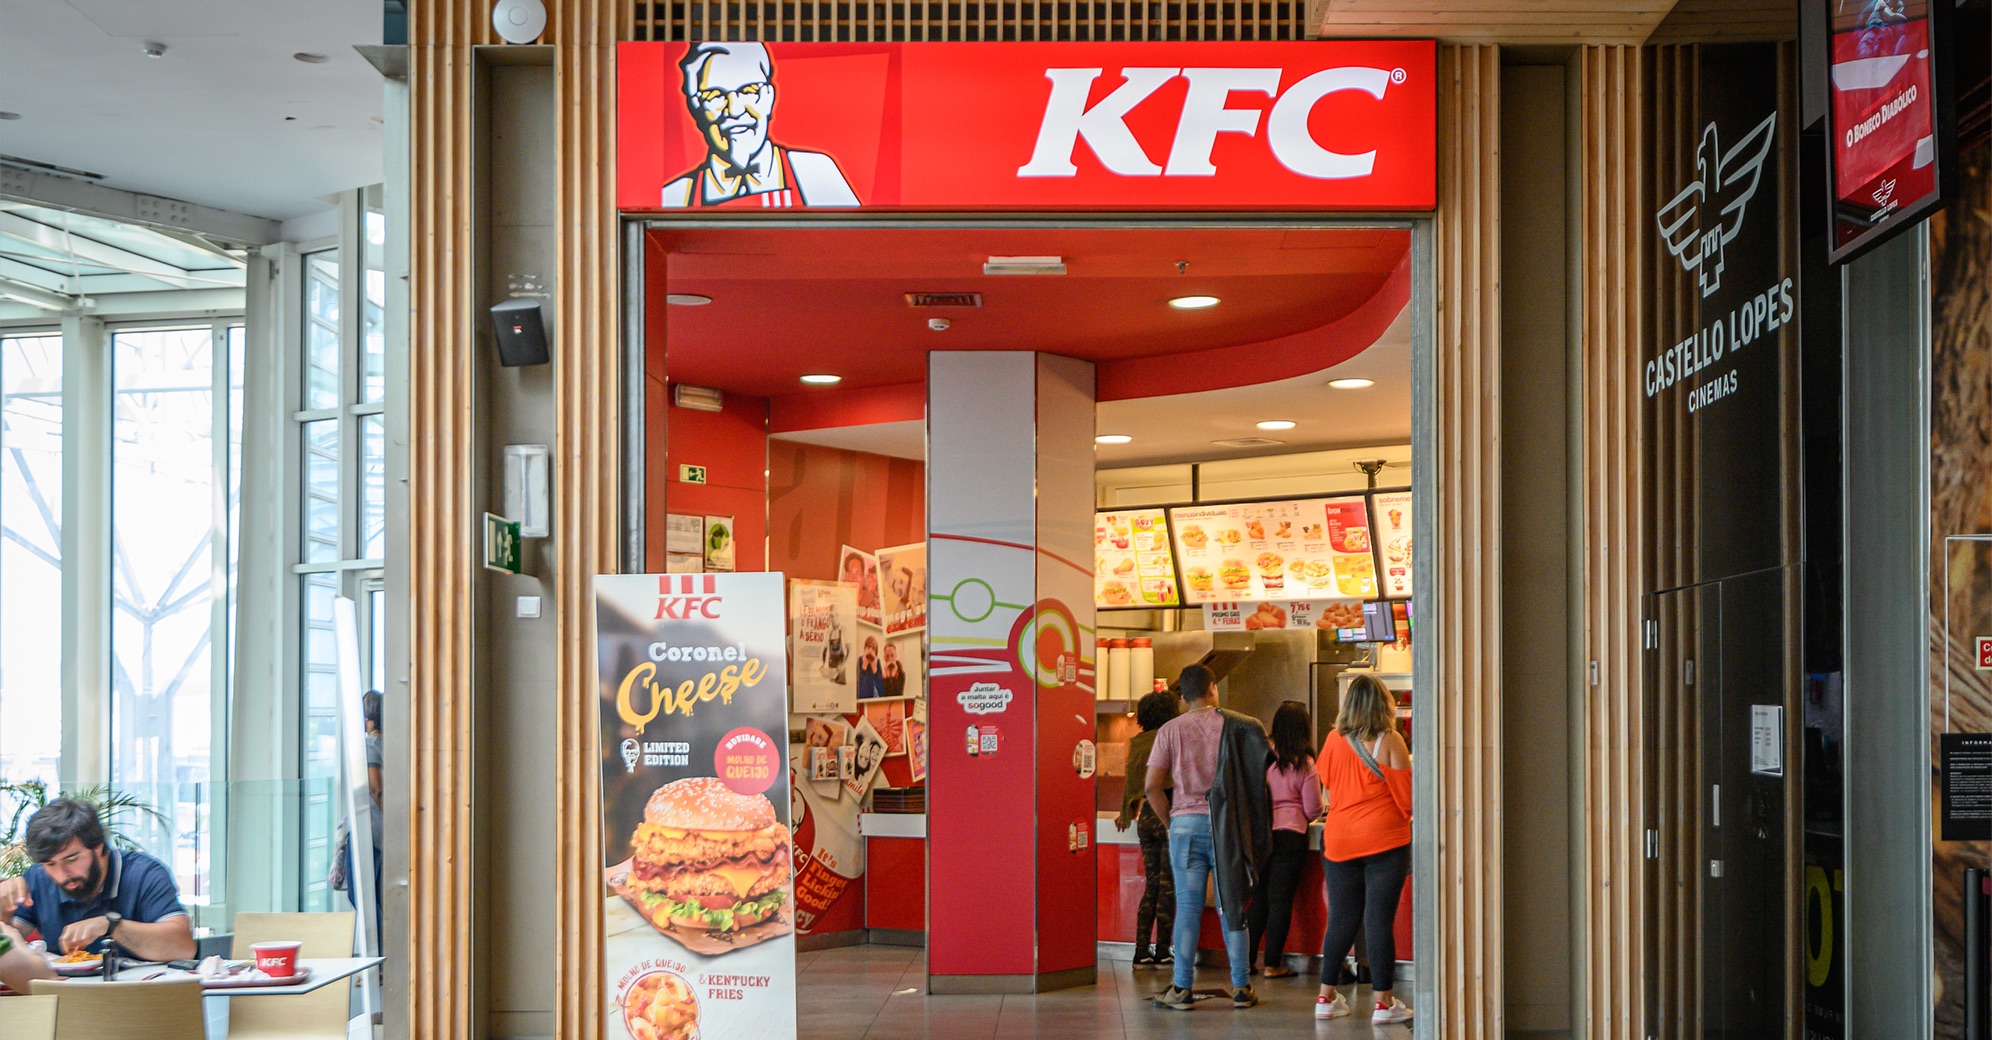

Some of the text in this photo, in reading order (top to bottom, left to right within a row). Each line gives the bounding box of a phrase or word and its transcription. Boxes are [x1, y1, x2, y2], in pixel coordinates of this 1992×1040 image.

[1017, 67, 1391, 178] KFC
[1846, 129, 1854, 148] O
[1854, 112, 1881, 143] BONECO
[1646, 277, 1794, 398] CASTELLO LOPES
[1688, 369, 1738, 413] CINEMAS
[1379, 496, 1412, 504] sobreme
[654, 597, 722, 620] KFC
[648, 642, 747, 661] Coronel
[616, 657, 768, 735] Cheese
[968, 700, 1003, 711] sogood
[643, 742, 690, 754] LIMITED
[725, 733, 767, 750] NOVIDADE
[643, 754, 689, 766] EDITION
[727, 755, 768, 764] MOLHO DE
[726, 765, 769, 779] QUEIJO
[817, 847, 837, 869] It's
[810, 860, 849, 889] Finger
[796, 885, 831, 910] Good!
[261, 956, 288, 967] KFC
[618, 957, 687, 990] MOLHO DE QUEIJO
[708, 975, 771, 988] KENTUCKY
[708, 989, 744, 1000] FRIES
